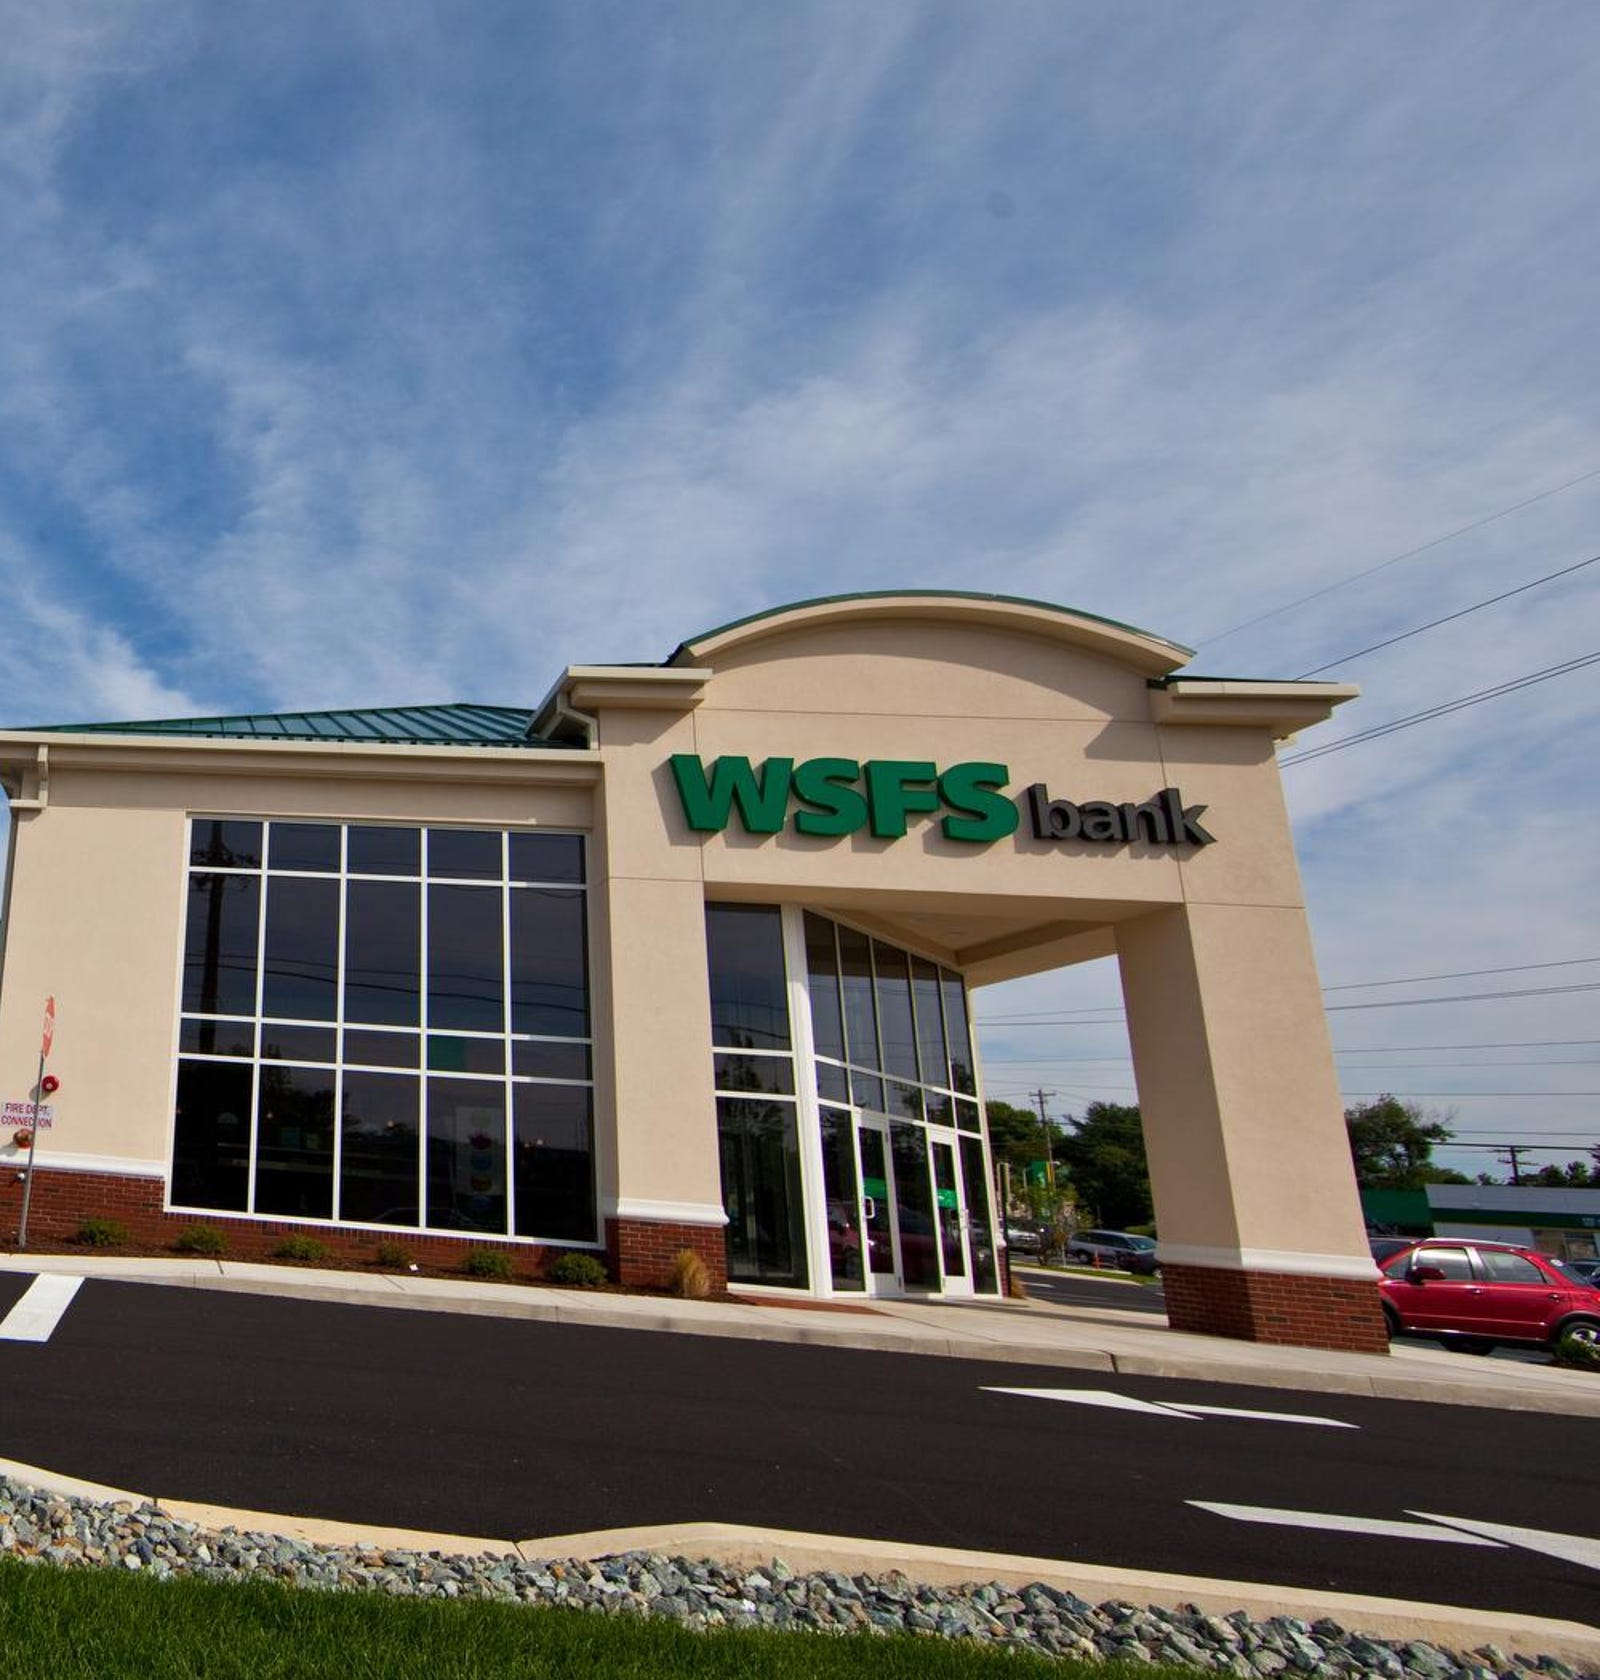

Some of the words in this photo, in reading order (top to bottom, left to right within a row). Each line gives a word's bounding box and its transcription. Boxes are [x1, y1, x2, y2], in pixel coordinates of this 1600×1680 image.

[670, 753, 1020, 842] WSFS
[1026, 783, 1217, 846] bank
[5, 1102, 24, 1113] FIRE
[1, 1115, 52, 1128] CONNECION
